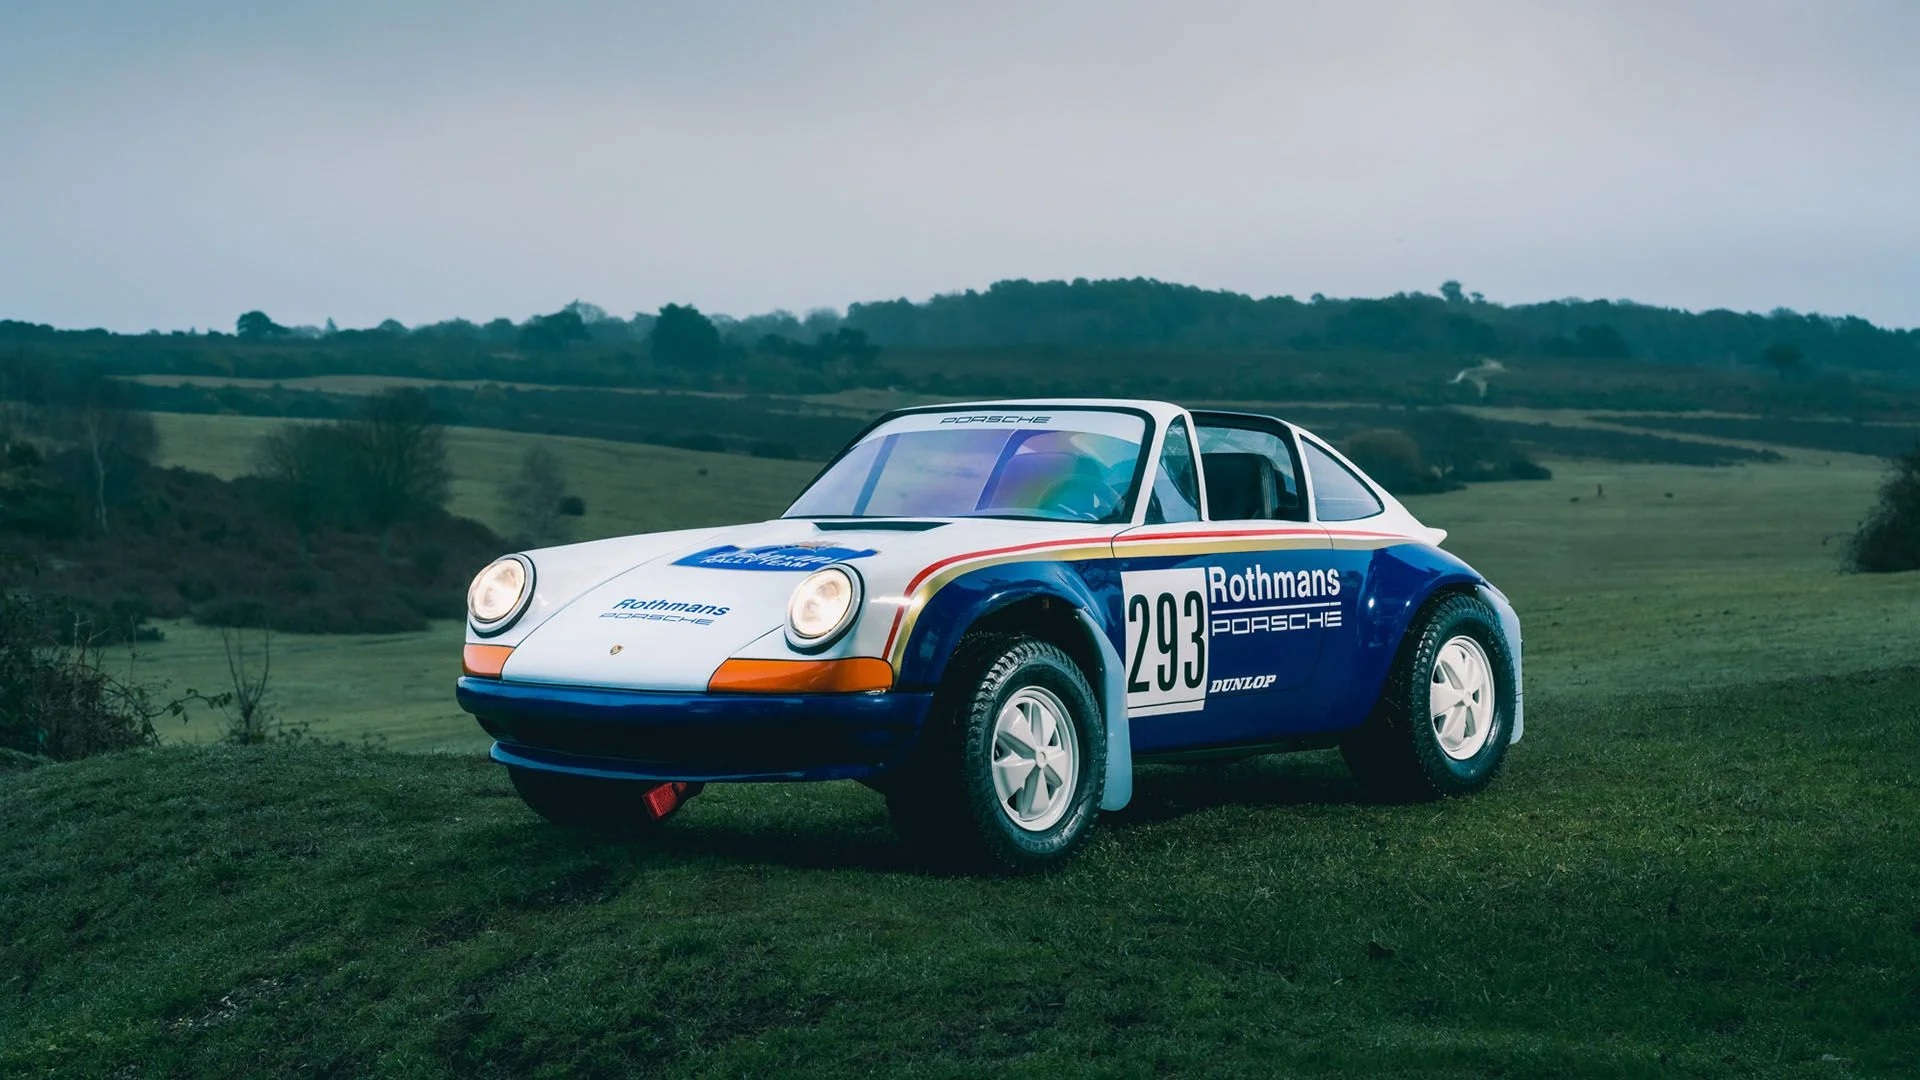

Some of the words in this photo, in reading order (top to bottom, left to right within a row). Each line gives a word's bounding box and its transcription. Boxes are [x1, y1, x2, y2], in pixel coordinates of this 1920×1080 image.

[940, 416, 1051, 424] PORSCHE
[699, 557, 754, 565] RALLY
[759, 559, 810, 568] TEAM
[1208, 564, 1341, 603] Rothmans
[612, 598, 731, 616] Rothmans
[599, 612, 715, 625] PORSCHE
[1212, 611, 1342, 636] PORSCHE
[1128, 590, 1205, 693] 293
[1209, 675, 1277, 693] DUNLOP
